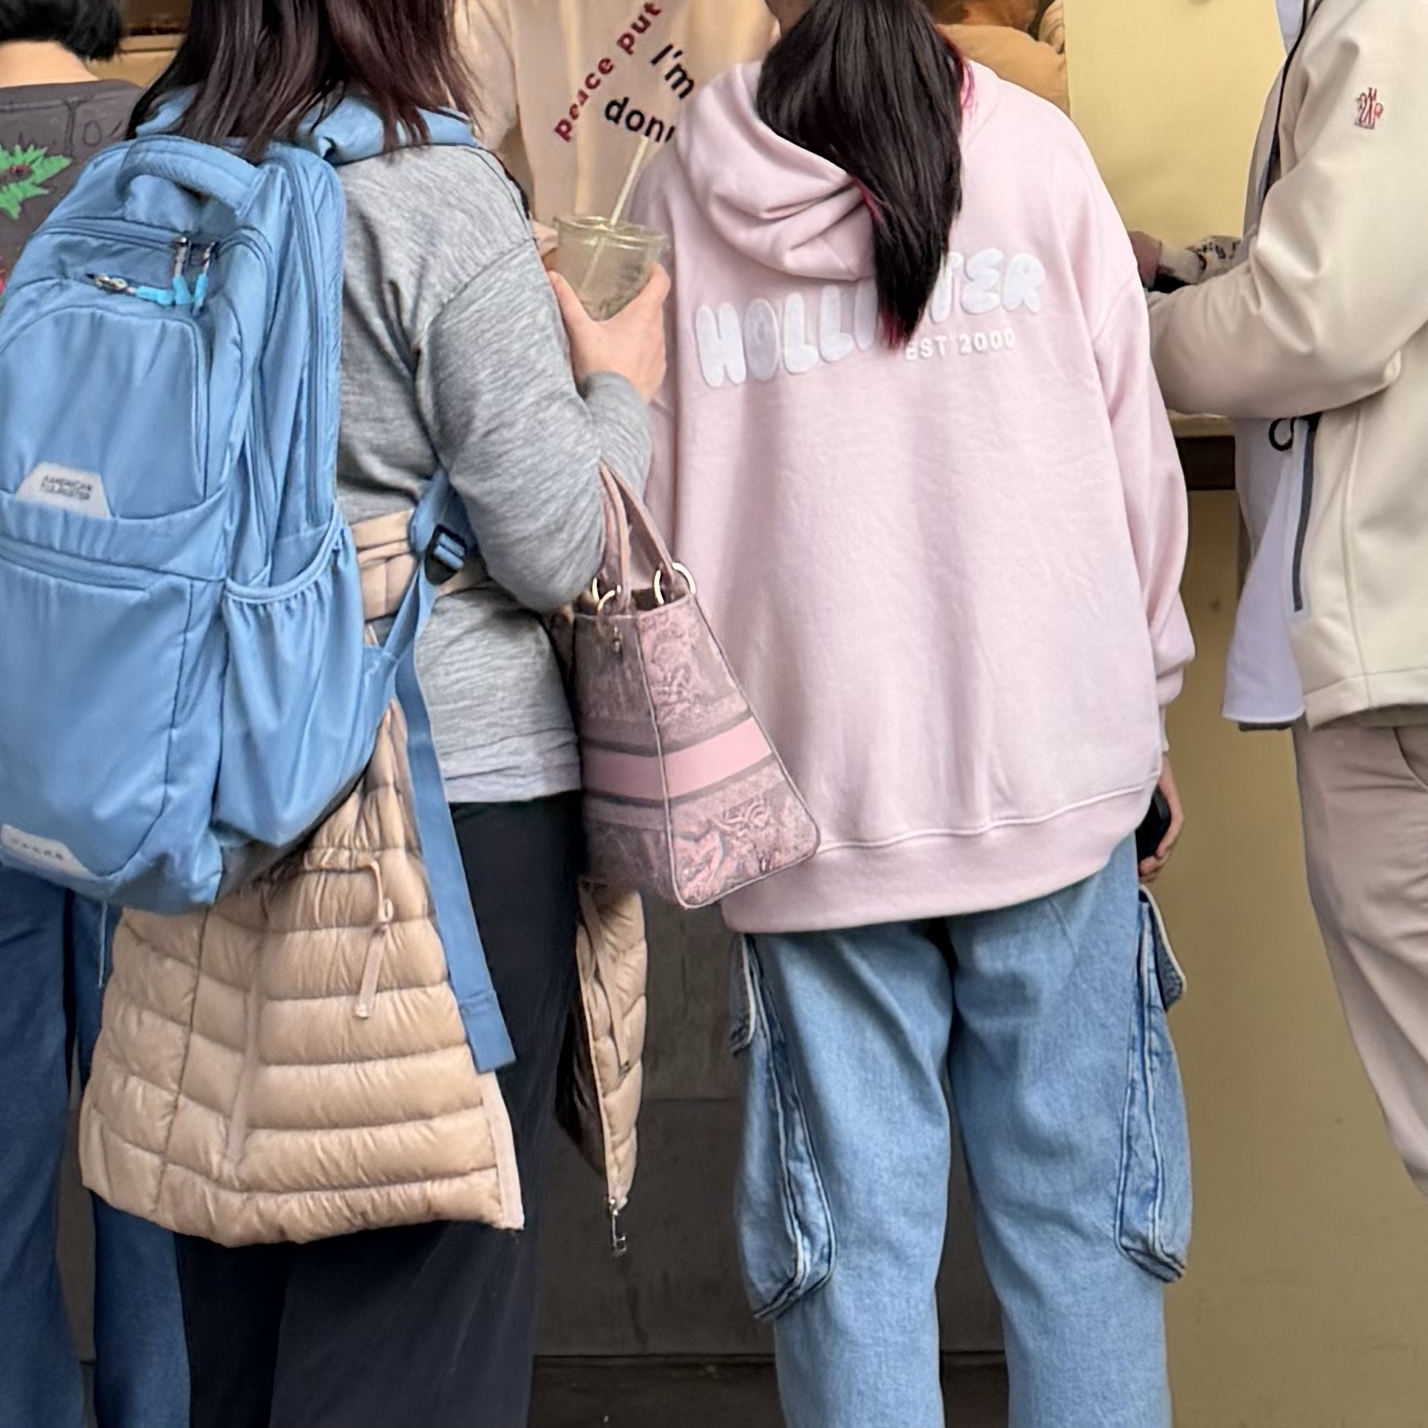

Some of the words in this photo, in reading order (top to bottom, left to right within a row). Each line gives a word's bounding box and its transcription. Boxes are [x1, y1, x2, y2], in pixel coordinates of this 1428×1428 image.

[554, 57, 614, 143] peace
[616, 2, 662, 56] put
[650, 44, 695, 100] I'm
[694, 247, 1047, 389] HOLLITER
[905, 334, 947, 361] EST
[957, 327, 1015, 356] 2000
